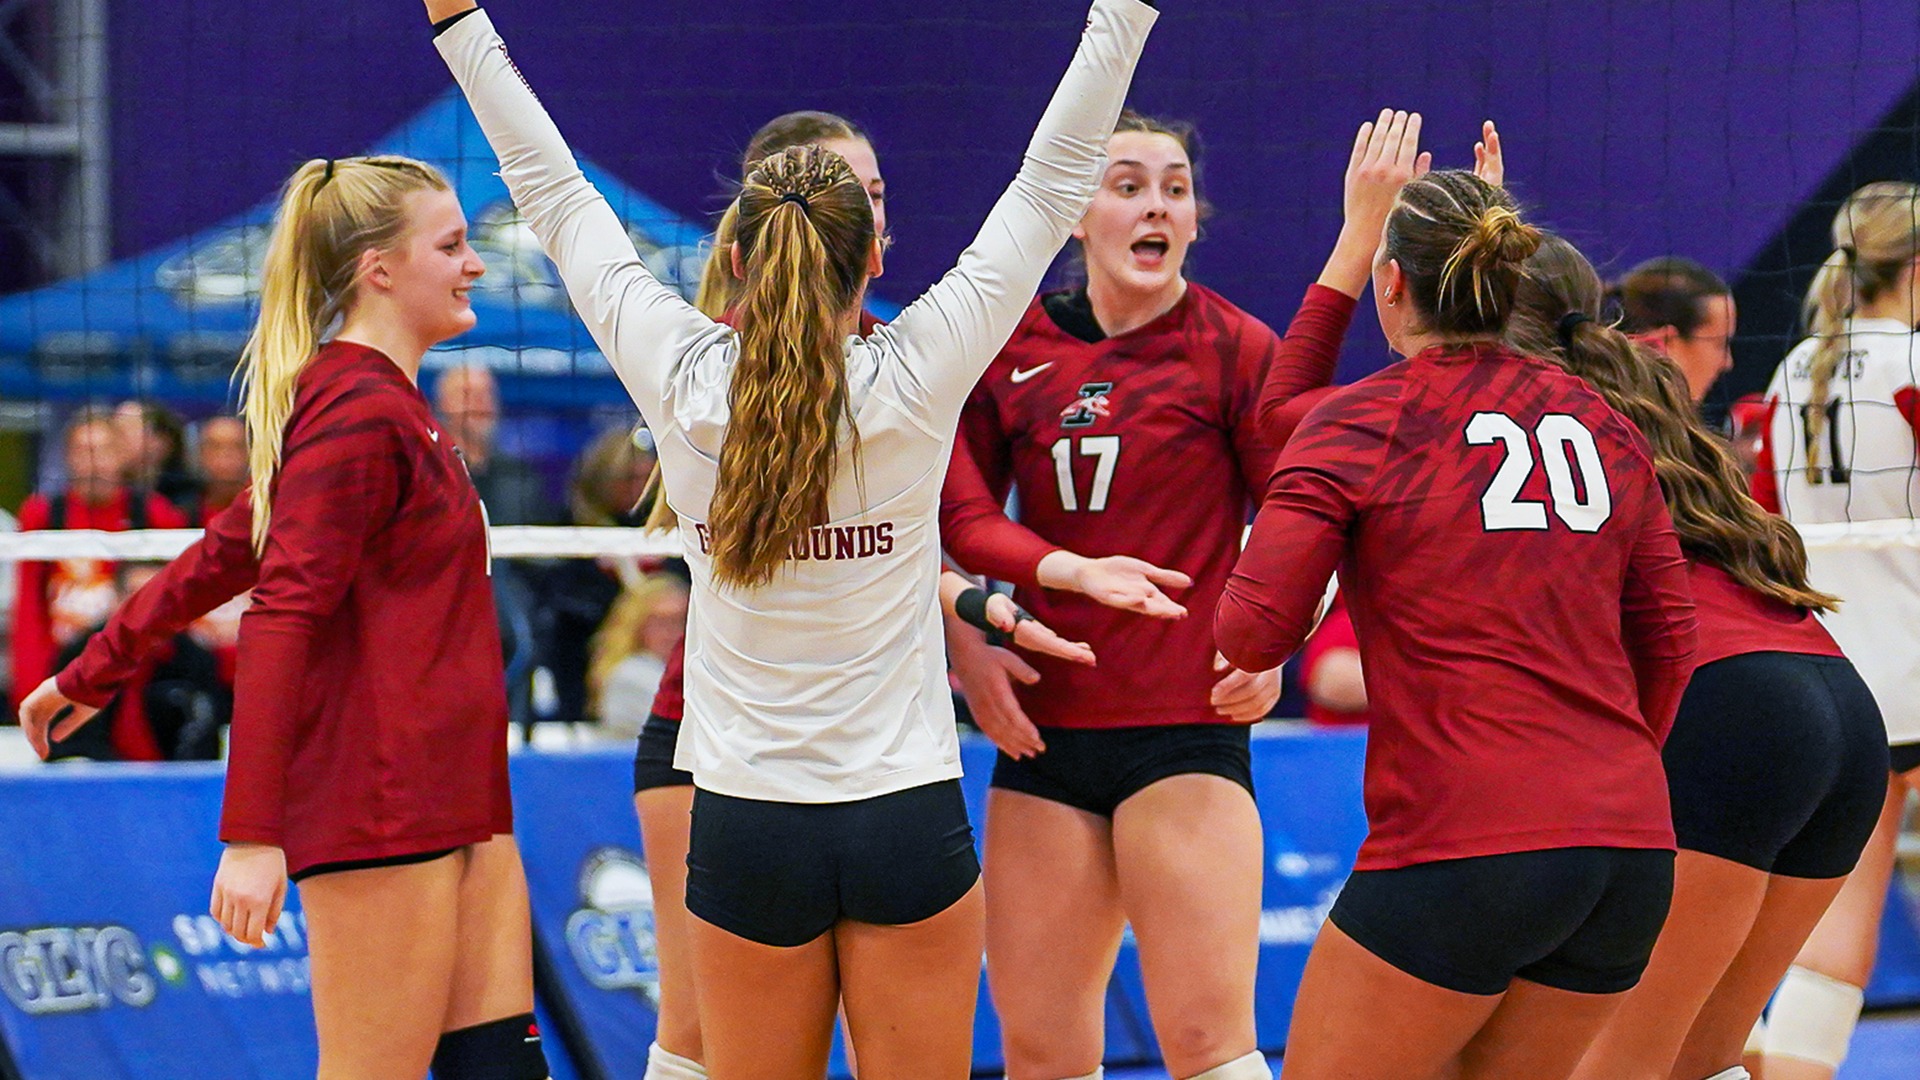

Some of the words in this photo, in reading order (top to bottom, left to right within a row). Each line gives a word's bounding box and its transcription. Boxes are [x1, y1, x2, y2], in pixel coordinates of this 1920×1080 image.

[1050, 434, 1121, 513] 17
[1463, 410, 1613, 534] 20
[695, 521, 894, 561] GOUNDS
